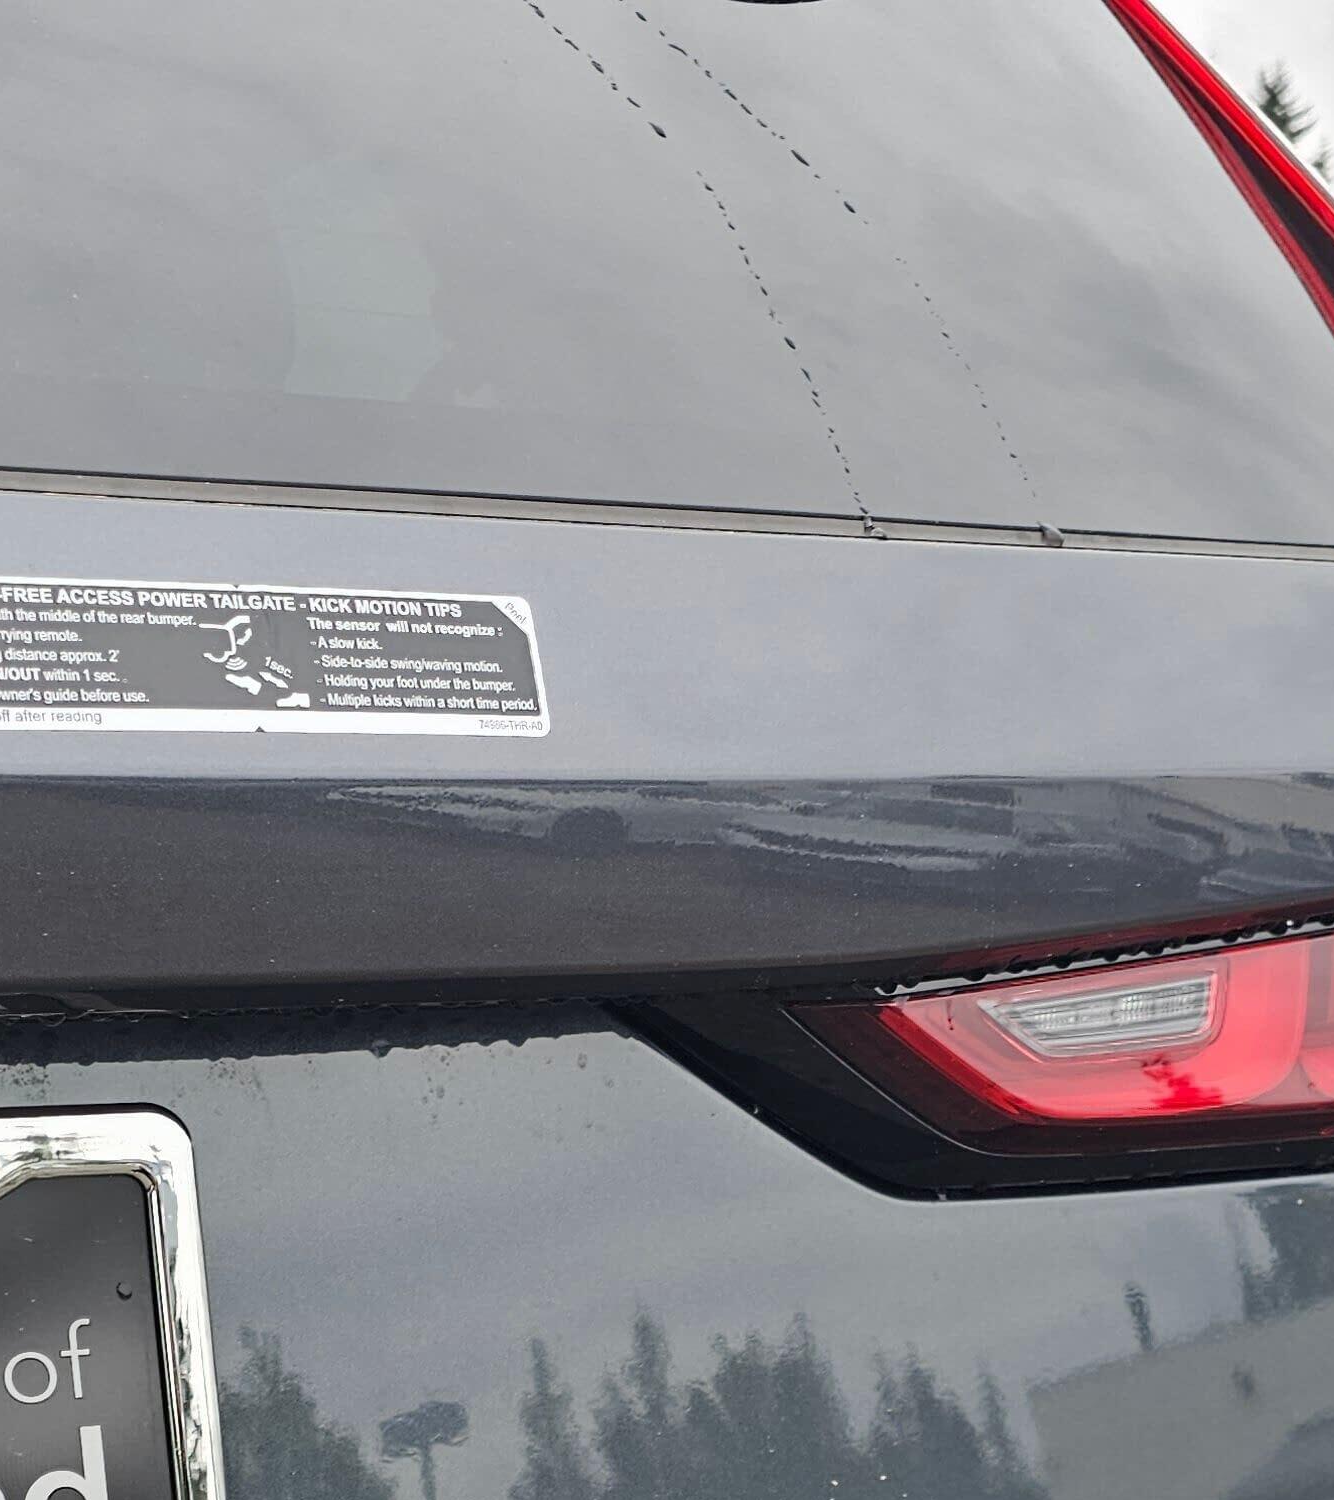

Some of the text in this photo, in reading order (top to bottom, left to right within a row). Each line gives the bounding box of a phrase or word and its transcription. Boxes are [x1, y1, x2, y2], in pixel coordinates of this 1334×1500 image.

[56, 588, 134, 606] ACCESS
[137, 591, 207, 608] POWER
[210, 593, 296, 611] TAILGATE
[309, 598, 351, 614] KICK
[353, 599, 421, 616] MOTION
[424, 602, 462, 618] TIPS
[16, 609, 36, 621] the
[40, 609, 80, 622] middle
[82, 610, 95, 622] of
[97, 611, 117, 623] the
[120, 614, 144, 624] rear
[147, 612, 196, 627] bumper.
[306, 617, 334, 630] The
[336, 619, 380, 631] sensor
[386, 620, 409, 633] will
[412, 623, 432, 634] not
[34, 629, 83, 642] remote.
[318, 636, 383, 650] A slow kick.
[4, 648, 57, 661] distance
[60, 652, 106, 664] approx.
[321, 655, 503, 673] Side-to-side swing/waving motion.
[43, 669, 80, 681] within
[83, 669, 90, 681] 1
[94, 671, 120, 682] sec.
[324, 674, 515, 693] Holding your foot under the bumper.
[44, 689, 78, 704] guide
[80, 688, 121, 702] before
[123, 692, 150, 702] use.
[328, 693, 537, 712] Multiple kicks within a short time period.
[16, 710, 45, 722] after
[51, 710, 102, 724] reading
[3, 1318, 92, 1405] of
